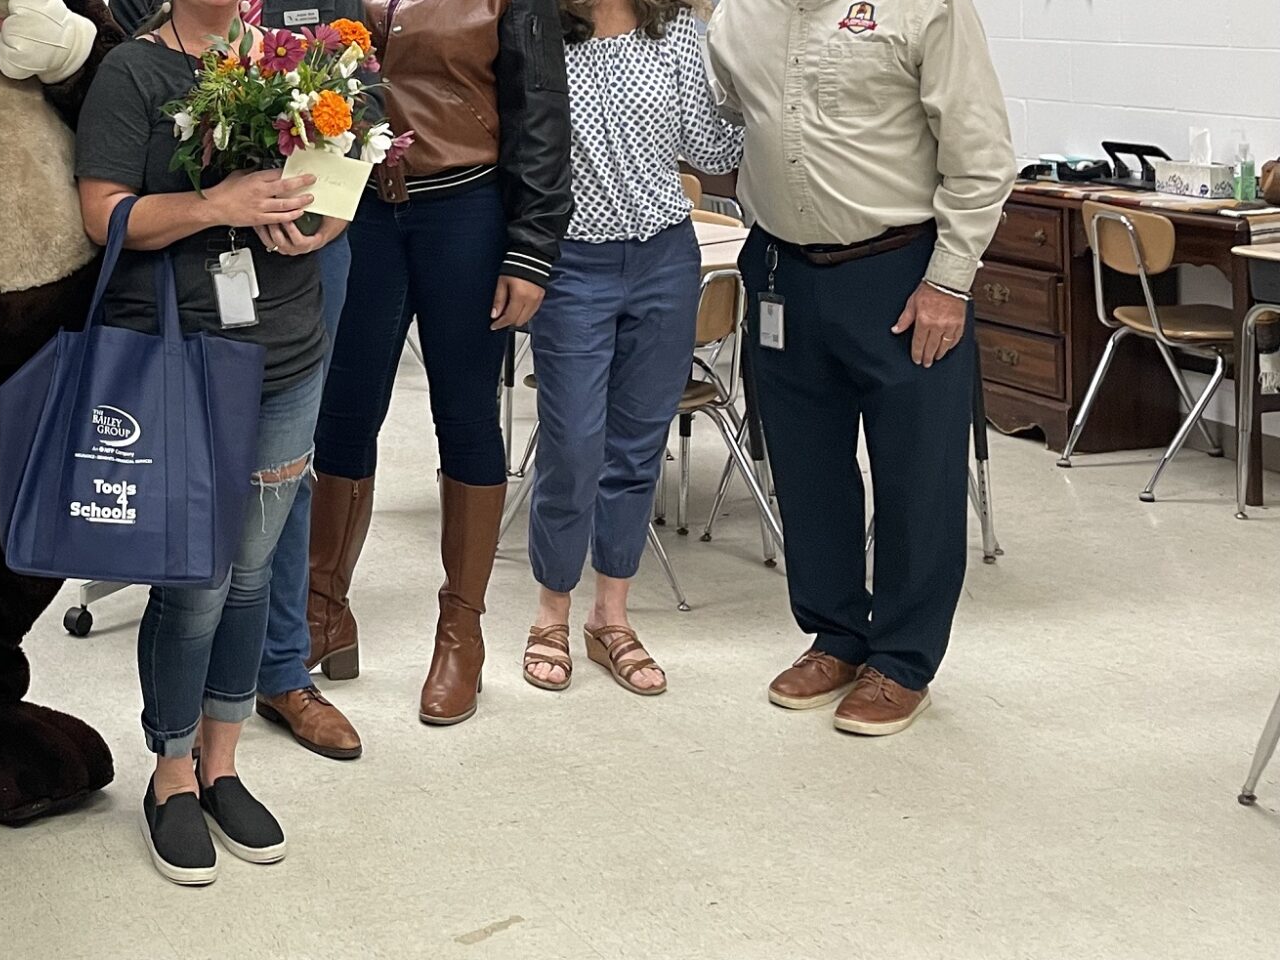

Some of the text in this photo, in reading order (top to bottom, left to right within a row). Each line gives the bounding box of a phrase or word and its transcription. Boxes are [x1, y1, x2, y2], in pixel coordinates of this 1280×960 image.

[92, 415, 122, 427] BAILEY
[97, 425, 131, 438] GROUP
[93, 479, 137, 496] Tools
[70, 501, 136, 520] Schools
